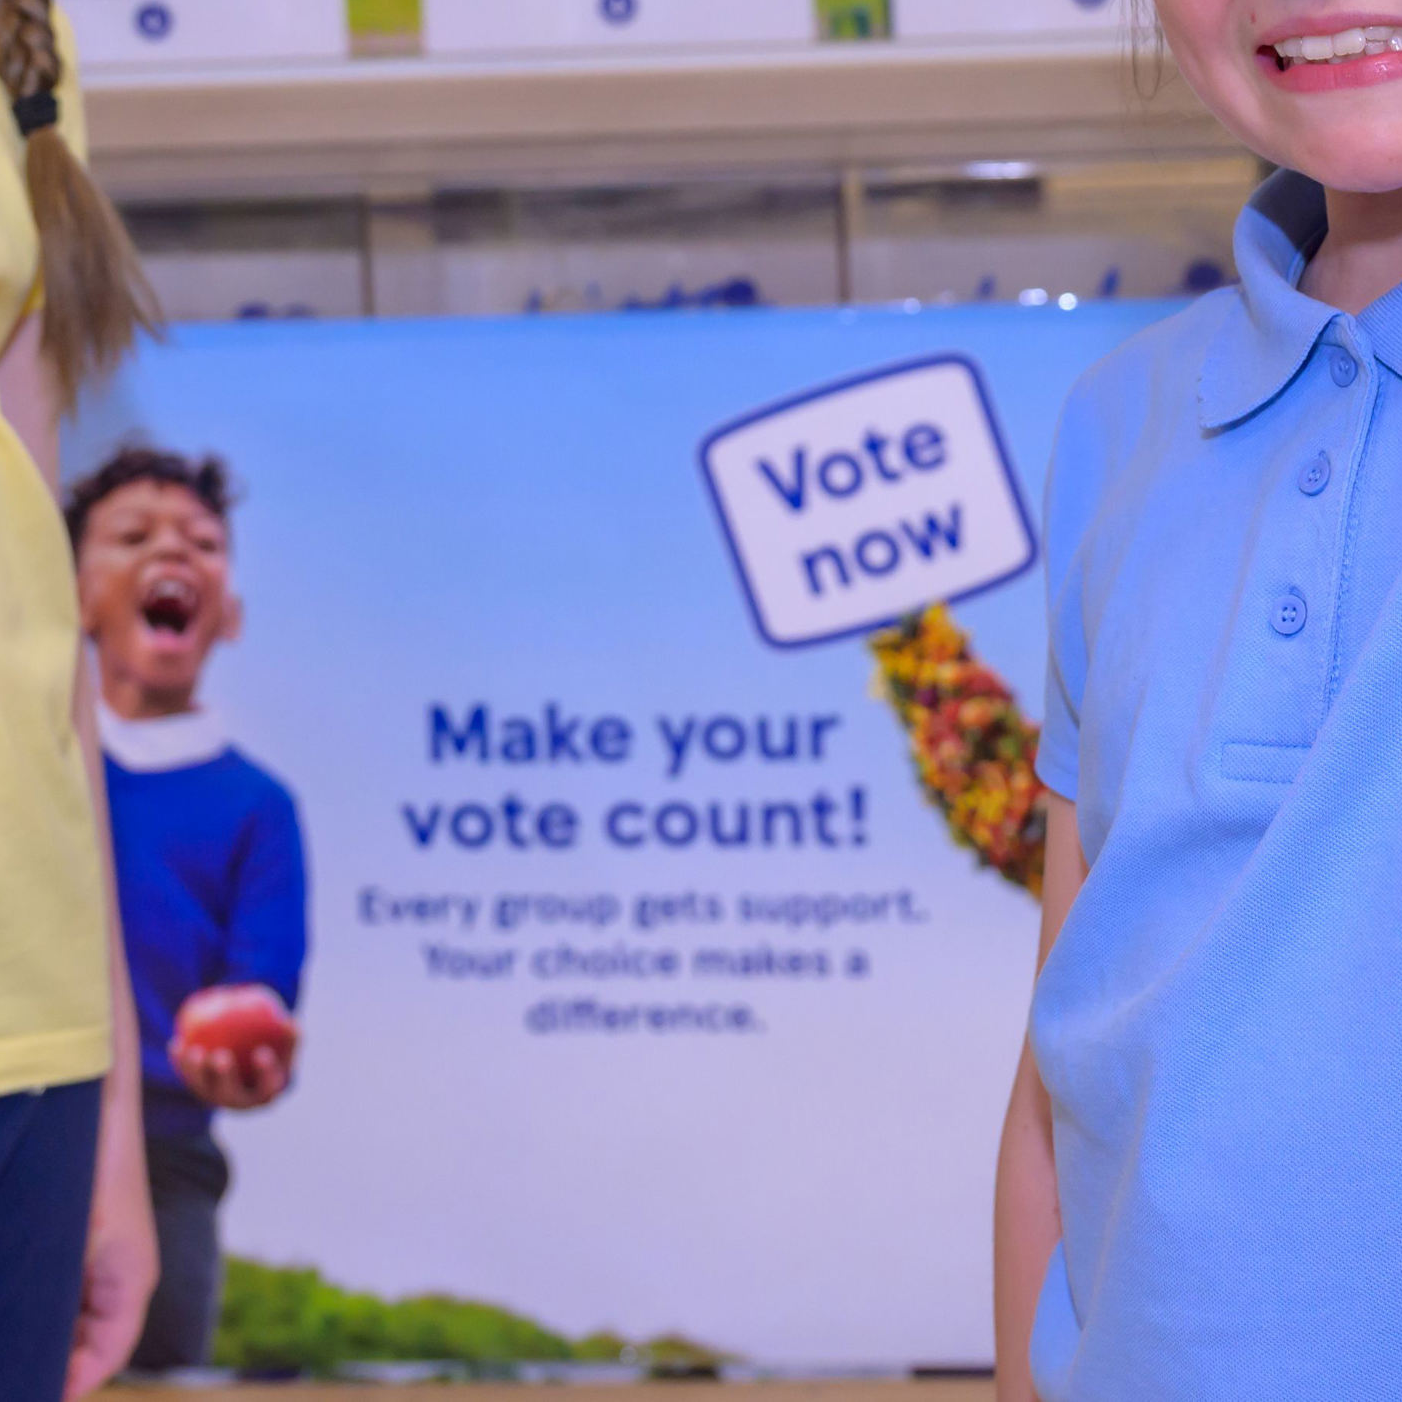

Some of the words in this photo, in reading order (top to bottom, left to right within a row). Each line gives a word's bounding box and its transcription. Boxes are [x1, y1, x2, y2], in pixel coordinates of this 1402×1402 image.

[756, 421, 946, 516] Vote
[799, 503, 965, 597] now
[429, 704, 632, 763] Make
[656, 713, 841, 779] your
[402, 795, 579, 850] vote
[604, 787, 868, 850] count!
[358, 888, 480, 927] Every
[492, 892, 622, 930] group
[633, 890, 724, 929] gets
[736, 888, 931, 930] support.
[422, 944, 516, 980] Your
[530, 943, 681, 980] choice
[692, 946, 831, 977] makes
[846, 950, 870, 977] a
[524, 998, 763, 1035] difference.
